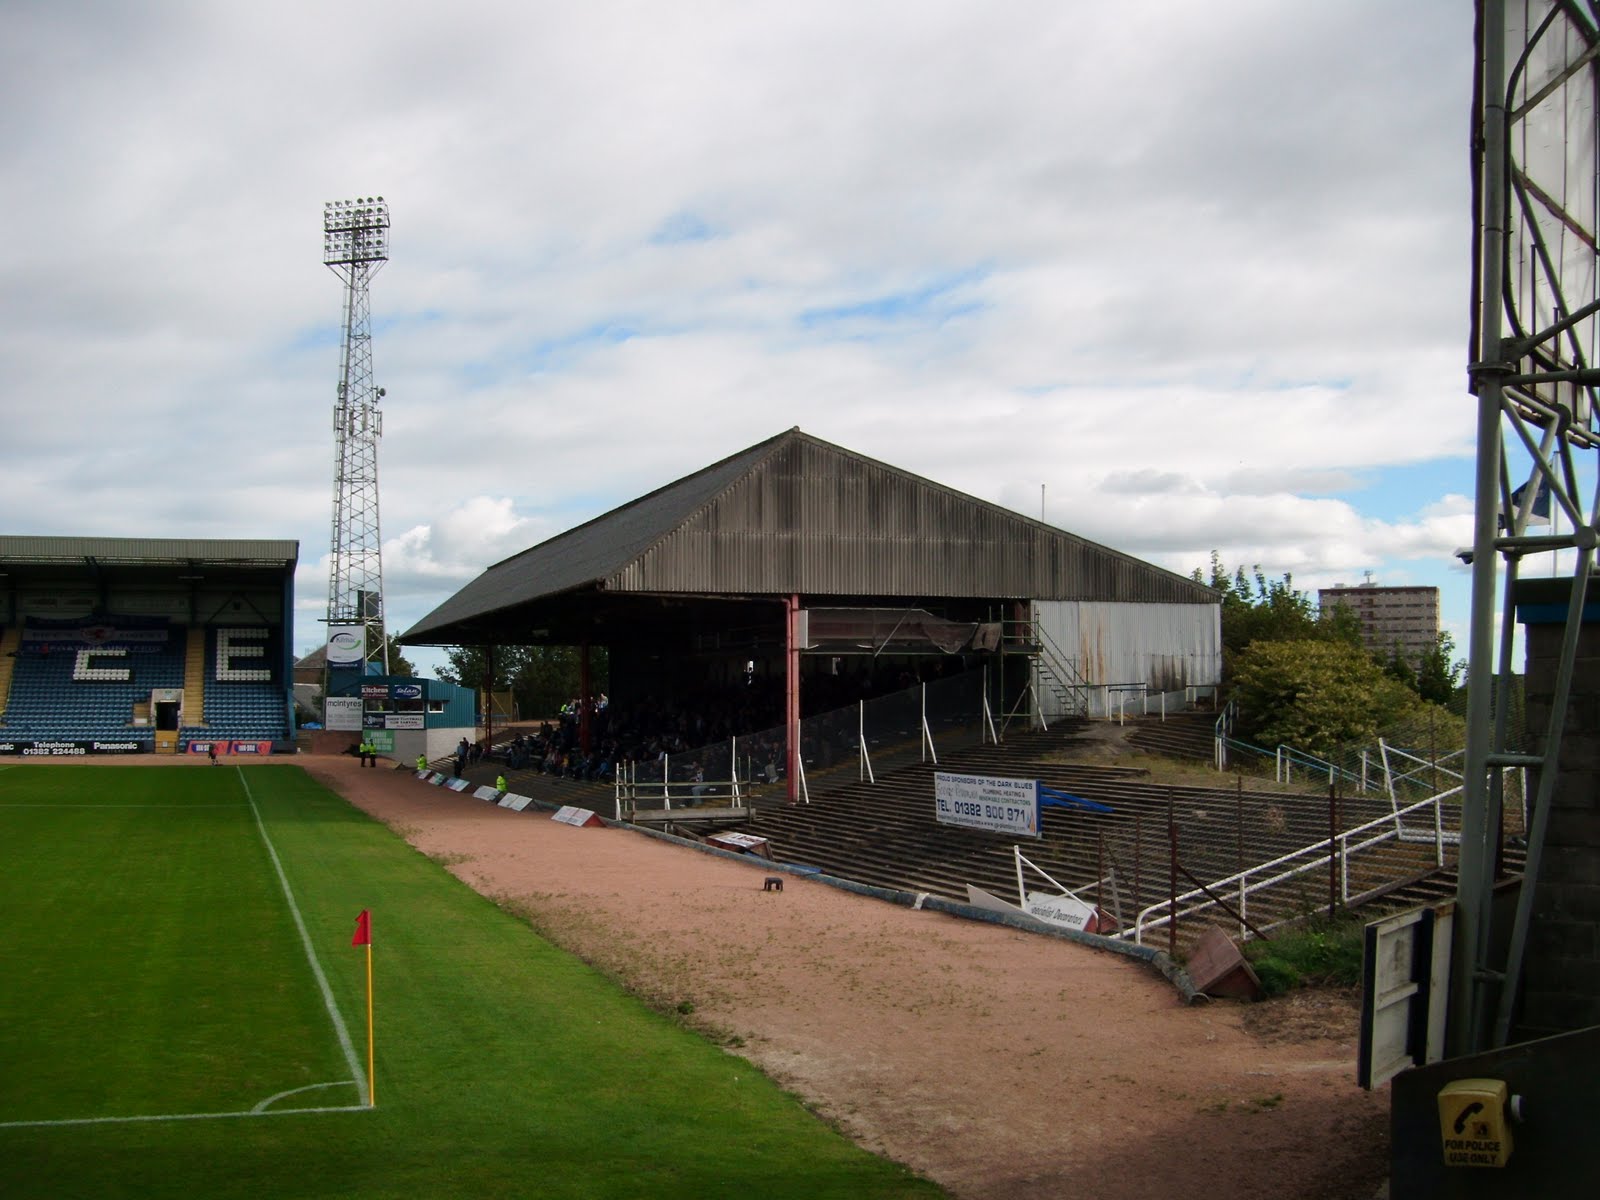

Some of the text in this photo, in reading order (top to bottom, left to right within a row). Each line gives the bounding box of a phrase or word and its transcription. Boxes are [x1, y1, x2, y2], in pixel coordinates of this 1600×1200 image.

[216, 627, 271, 682] E
[33, 741, 75, 749] Telephone
[93, 741, 138, 750] Panasonic
[937, 774, 951, 783] PROUD
[951, 776, 977, 785] SPONSORS
[997, 780, 1012, 788] DARK
[1014, 782, 1033, 790] BLUES
[1003, 789, 1022, 798] HEATING
[936, 798, 1026, 823] TEL. 01382 800 971
[1053, 908, 1084, 925] Decorators
[1445, 1139, 1501, 1151] FOR POLICE
[1449, 1152, 1497, 1164] USE ONLY
